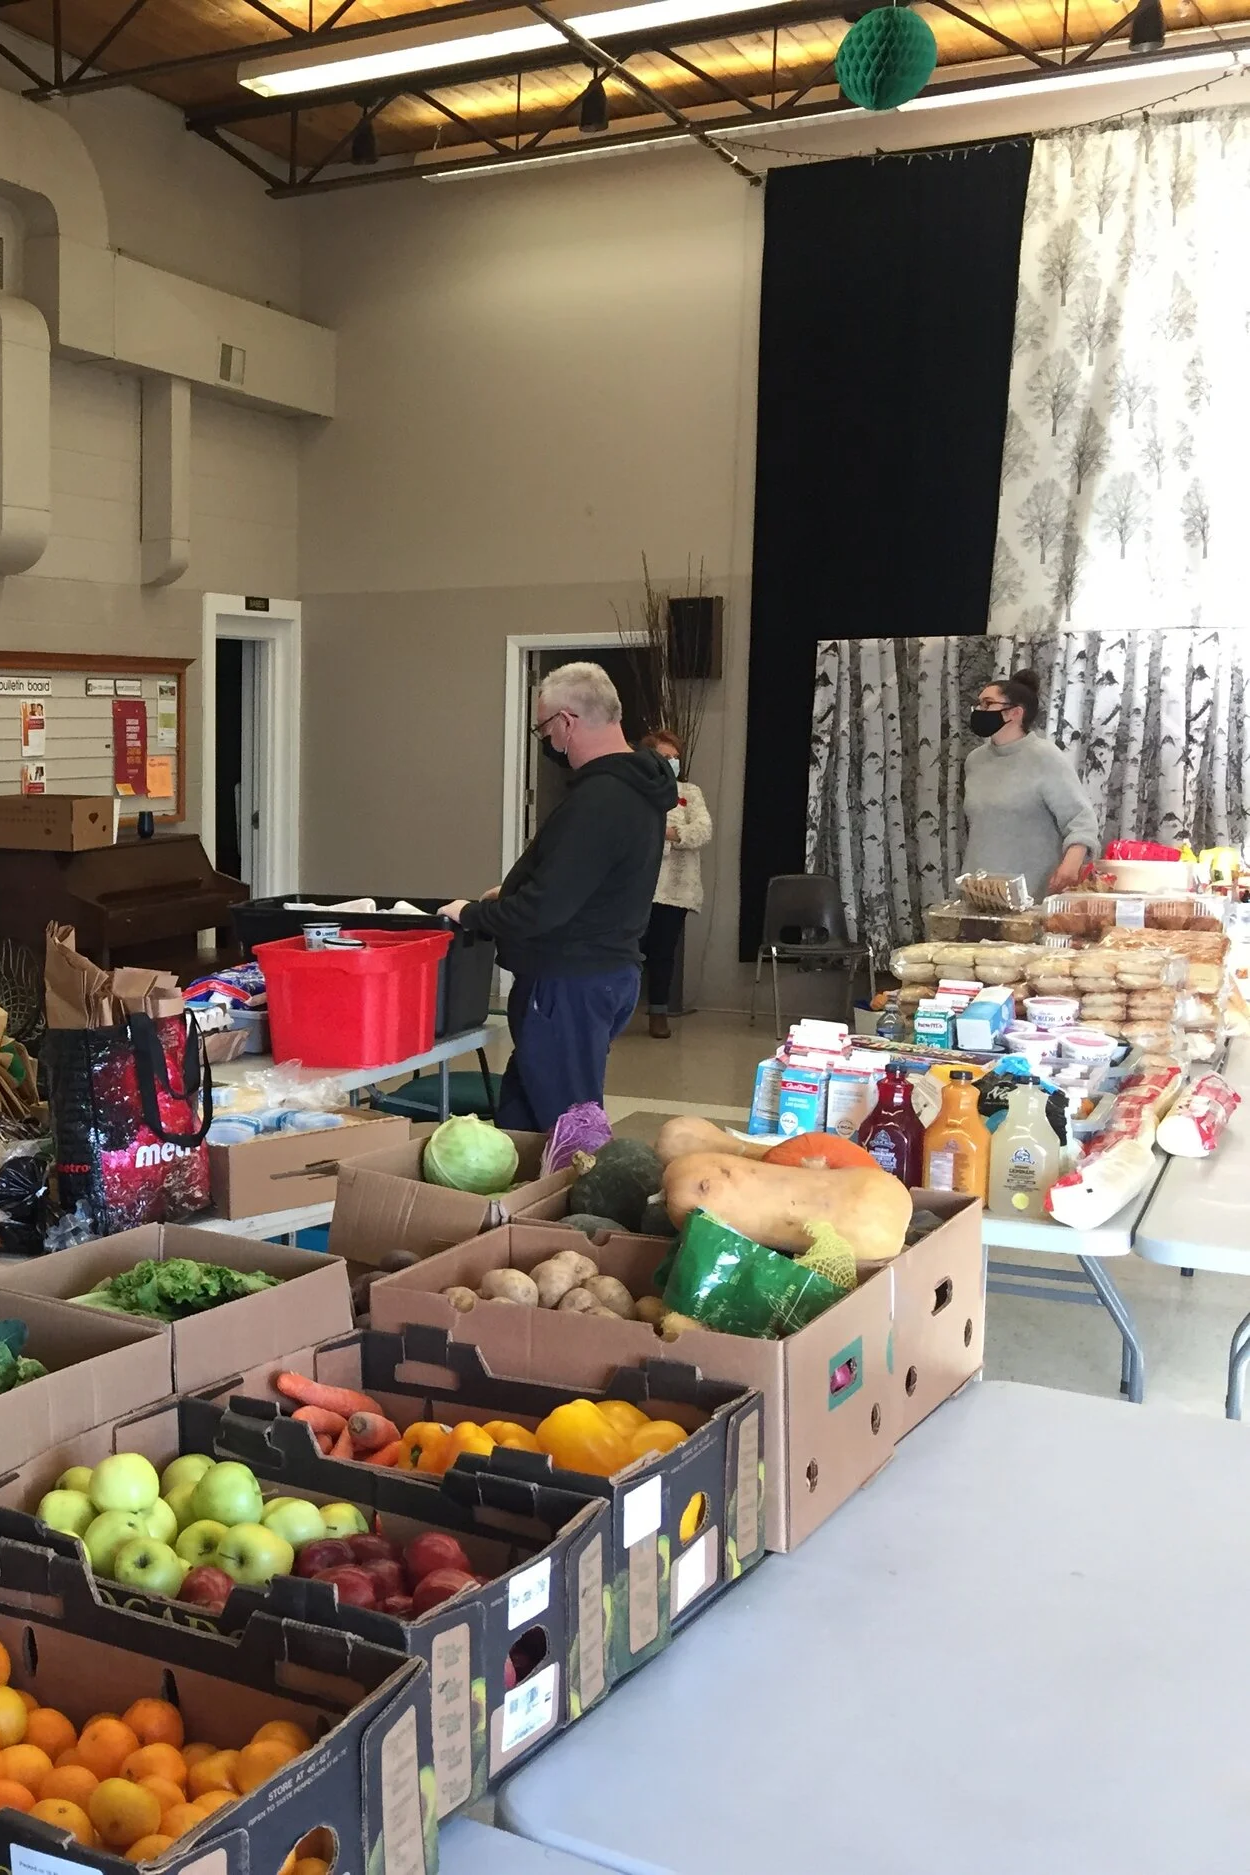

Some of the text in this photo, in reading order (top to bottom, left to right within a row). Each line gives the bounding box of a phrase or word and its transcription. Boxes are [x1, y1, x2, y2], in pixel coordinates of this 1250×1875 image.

[27, 679, 50, 691] board
[135, 1142, 200, 1168] met
[266, 1778, 294, 1802] STORE
[295, 1769, 306, 1783] AT
